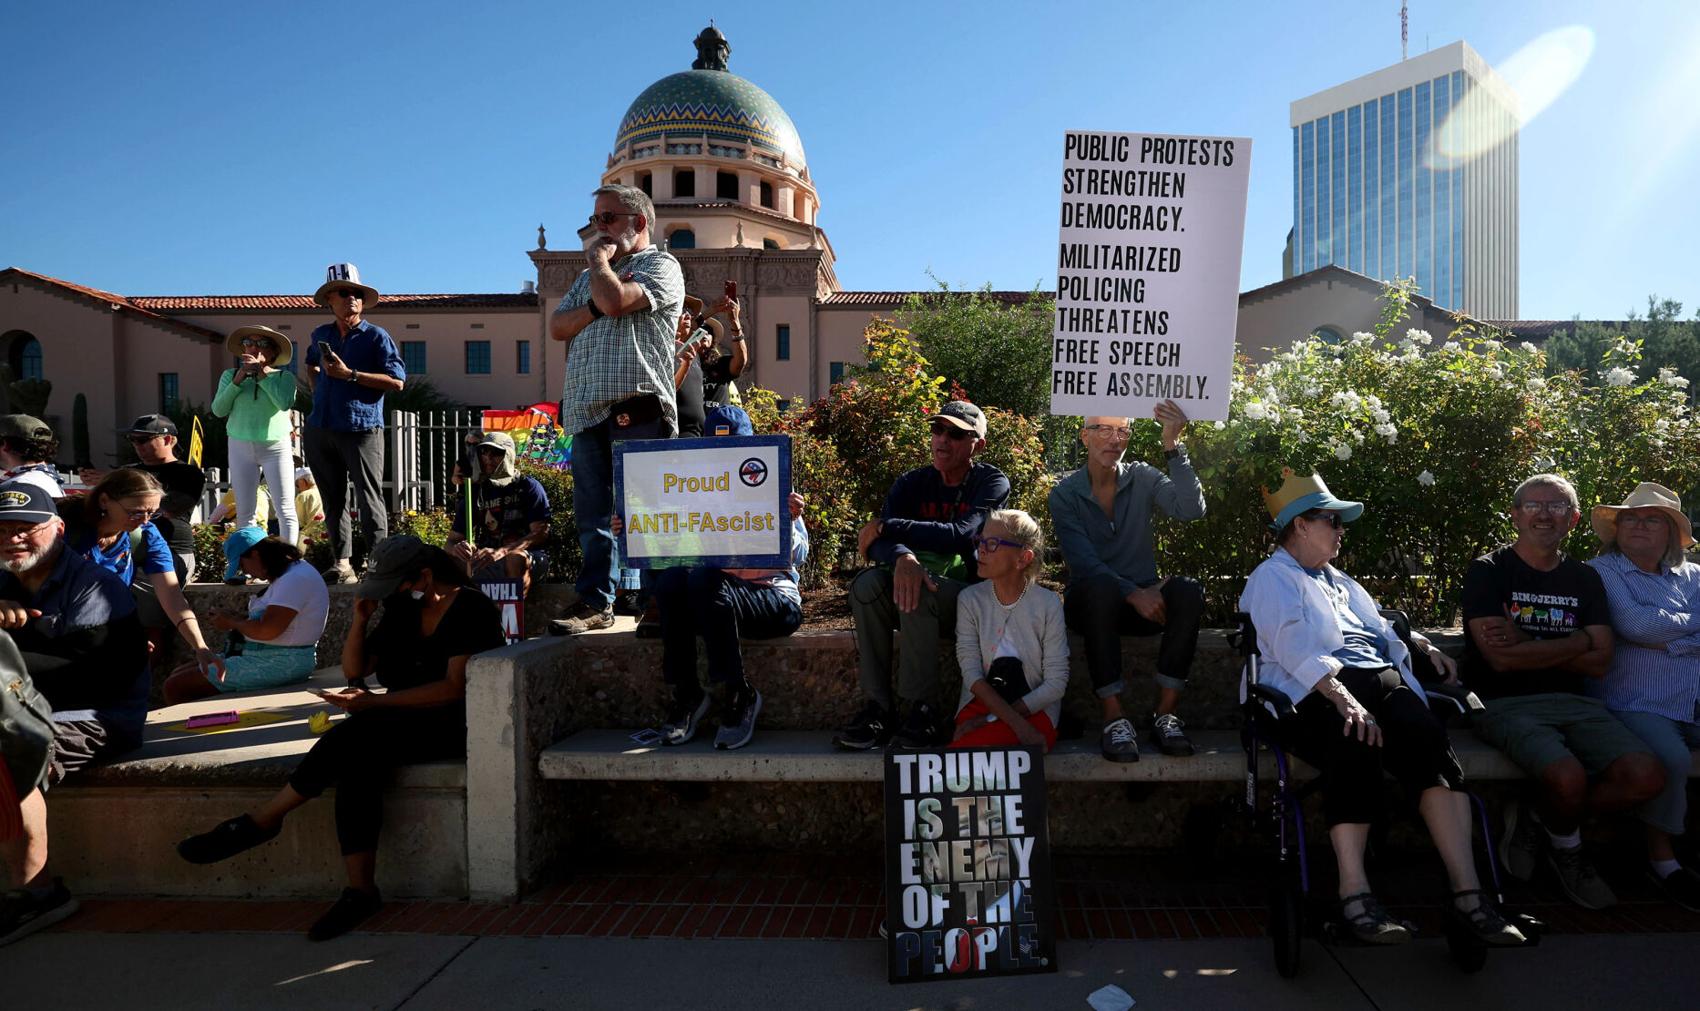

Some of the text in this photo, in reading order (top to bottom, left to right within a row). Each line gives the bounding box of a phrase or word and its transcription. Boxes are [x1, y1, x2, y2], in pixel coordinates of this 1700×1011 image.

[1064, 134, 1234, 166] PUBLIC PROTESTS
[1064, 168, 1186, 198] STRENGTHEN
[1062, 202, 1185, 232] DEMOCRACY.
[1060, 244, 1181, 272] MILITARIZED
[1058, 276, 1145, 304] POLICING
[1058, 307, 1169, 335] THREATENS
[1055, 338, 1180, 368] FREE SPEECH
[1053, 370, 1210, 400] FREE ASSEMBLY.
[664, 472, 729, 494] Proud
[628, 511, 775, 534] ANTI-FAscist
[481, 583, 518, 600] THAN
[894, 751, 1031, 794] TRUMP
[903, 795, 1025, 840] IS THE
[901, 837, 1035, 885] ENEMY
[902, 880, 1034, 929] OF THE
